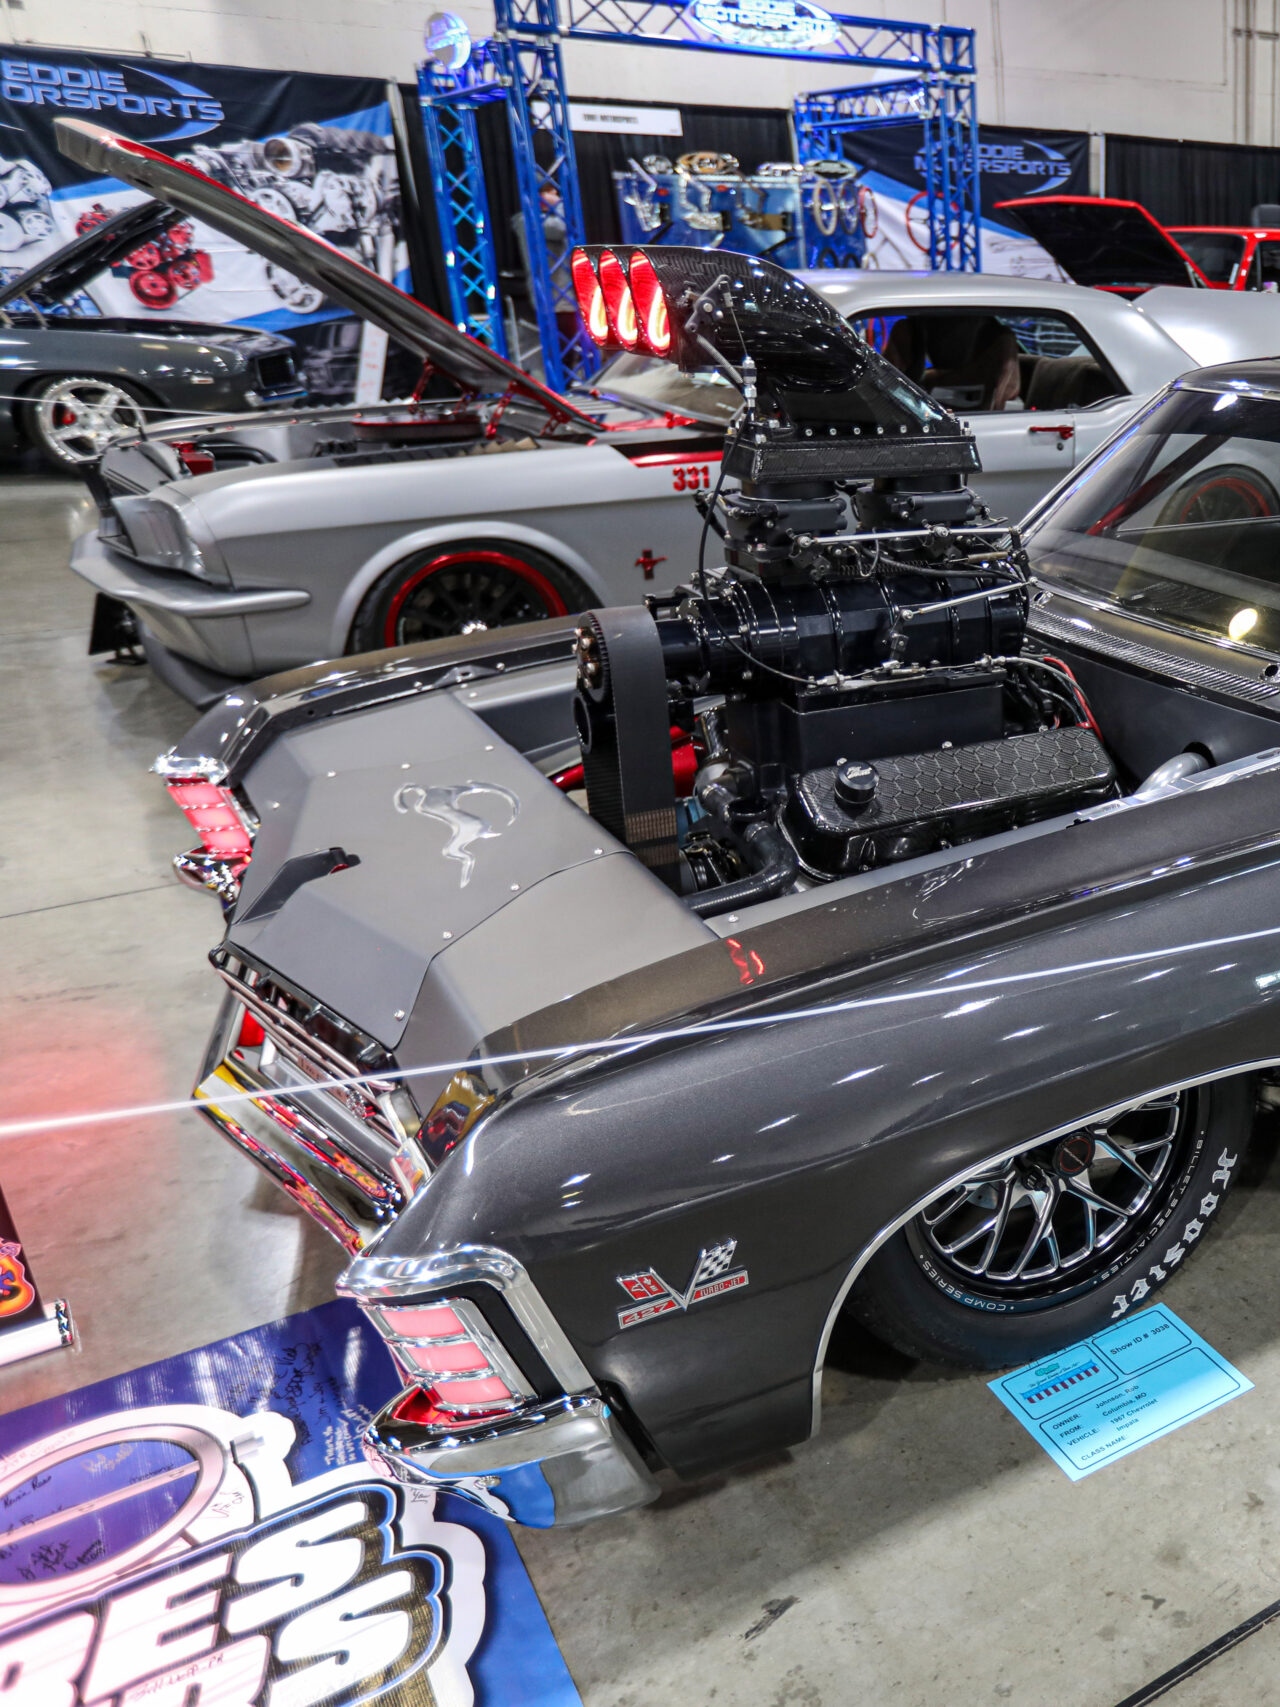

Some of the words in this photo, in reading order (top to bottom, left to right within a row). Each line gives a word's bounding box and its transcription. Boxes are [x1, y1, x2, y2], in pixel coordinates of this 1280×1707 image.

[0, 59, 128, 92] EDDIE
[672, 464, 711, 492] 331
[1179, 1139, 1205, 1195] BILLET
[1100, 1197, 1179, 1281] SPECIALTIES
[922, 1260, 963, 1299] SERIES
[623, 1301, 670, 1325] 427
[964, 1296, 1007, 1312] COMP
[1110, 1341, 1133, 1355] Show
[1132, 1336, 1143, 1344] ID
[1052, 1413, 1082, 1430] OWNER:
[1081, 1446, 1106, 1461] CLASS
